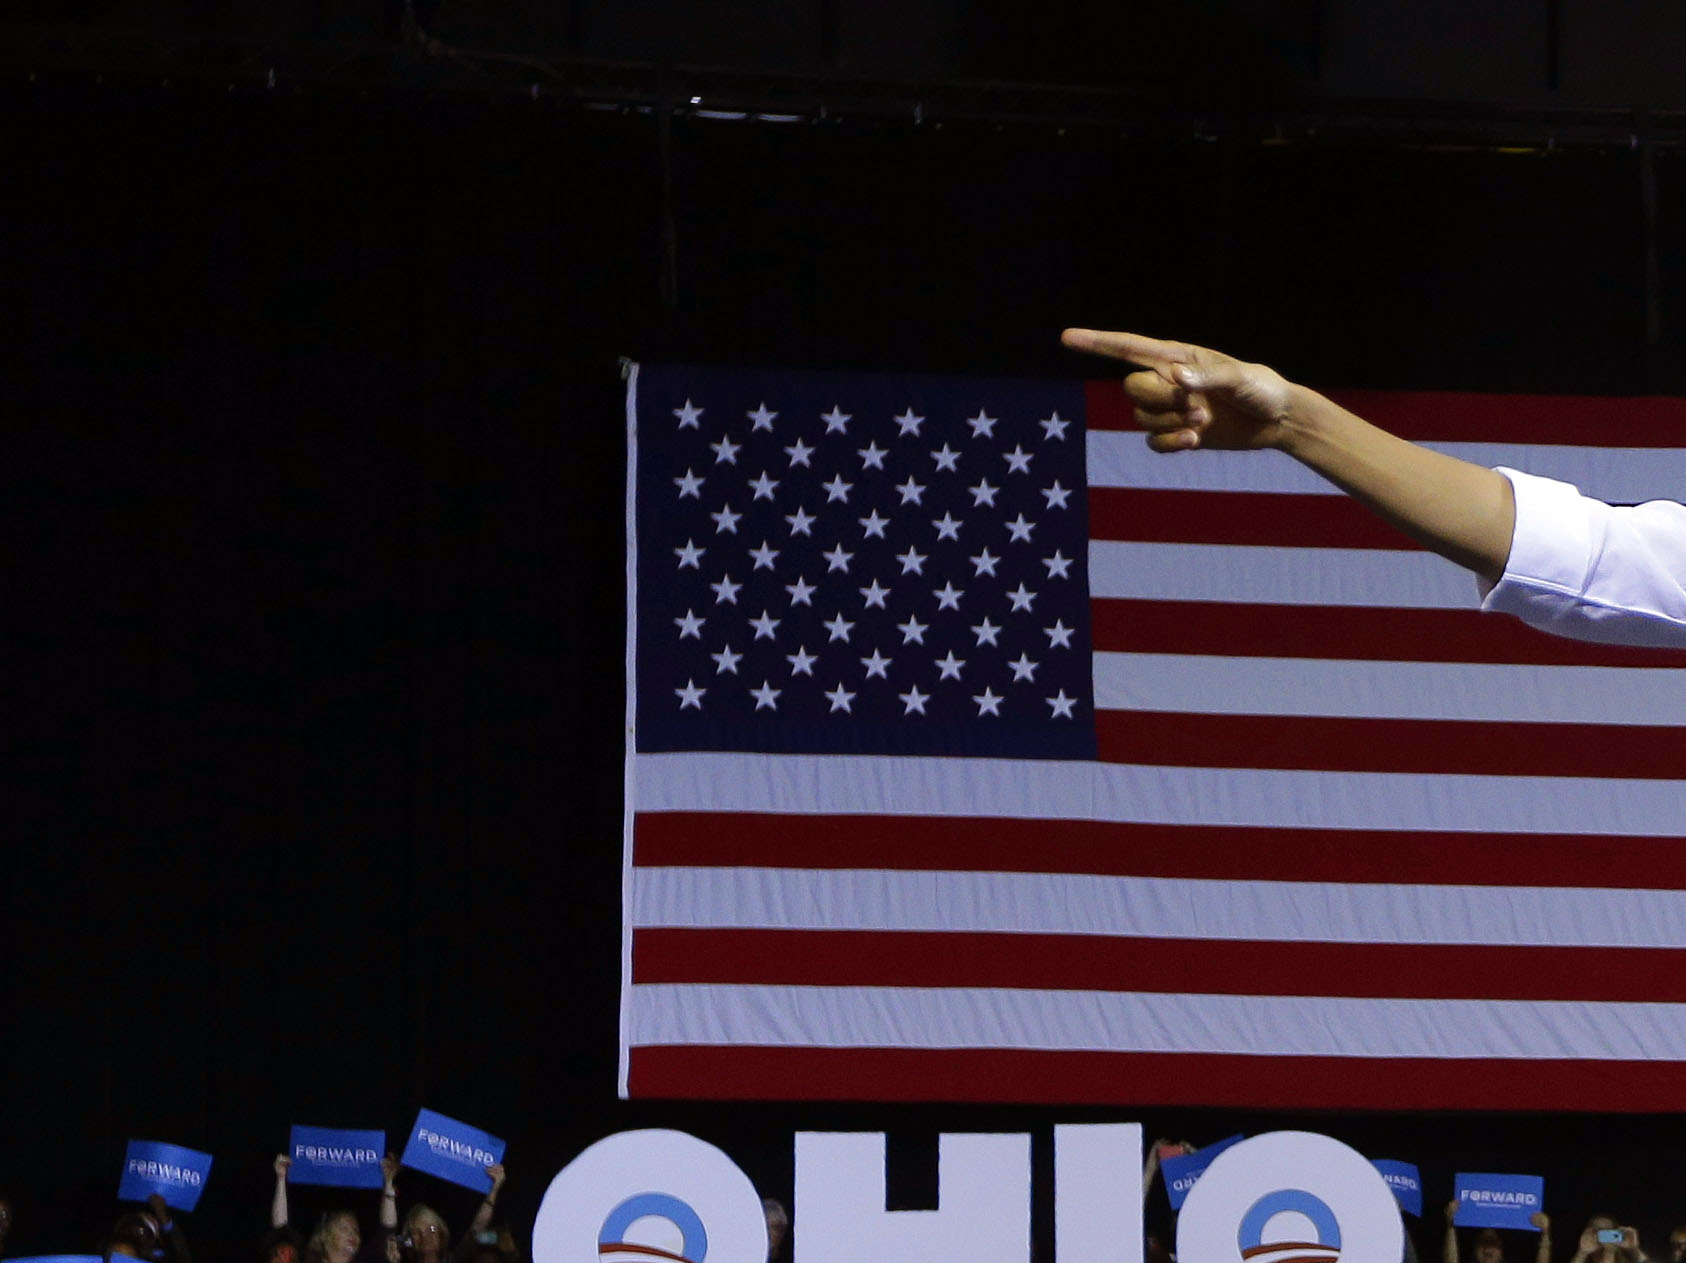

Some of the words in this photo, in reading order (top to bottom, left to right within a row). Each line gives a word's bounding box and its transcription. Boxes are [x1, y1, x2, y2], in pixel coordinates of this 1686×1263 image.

[295, 1144, 378, 1162] FORWARD
[418, 1128, 495, 1167] FORWARD
[128, 1158, 201, 1186] FORWARD
[1460, 1189, 1537, 1206] FORWARD
